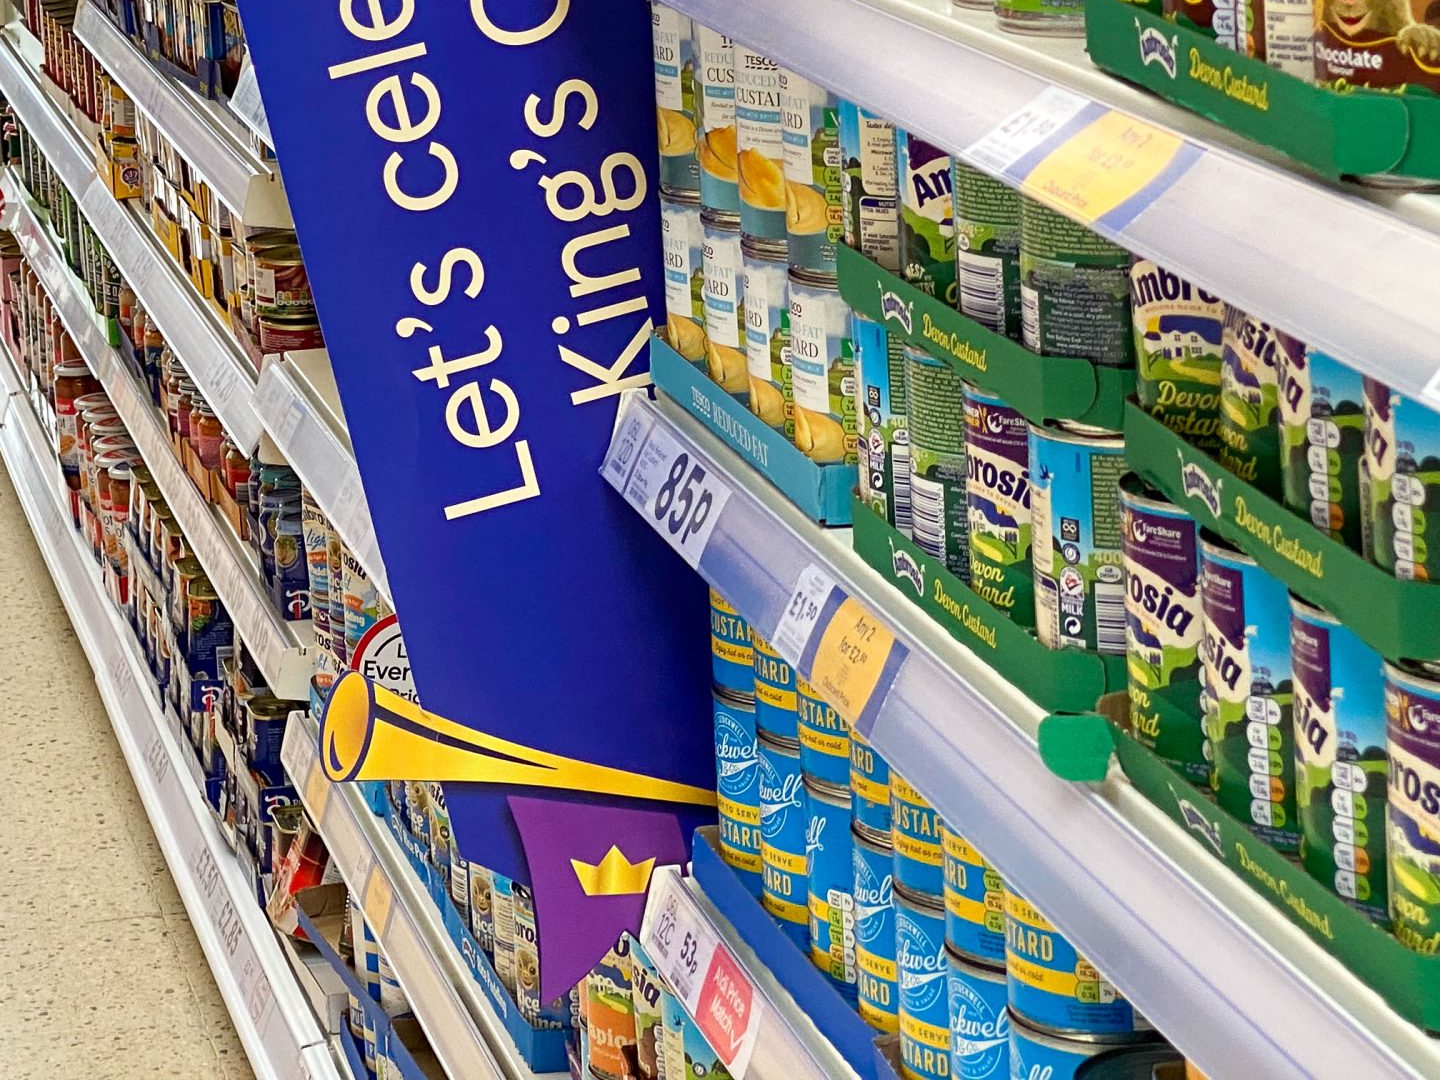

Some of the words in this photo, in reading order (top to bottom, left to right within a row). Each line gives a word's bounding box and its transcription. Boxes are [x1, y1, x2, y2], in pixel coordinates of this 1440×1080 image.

[744, 55, 778, 67] TESCO
[1314, 39, 1384, 72] Chocolate
[1189, 48, 1224, 95] Devon
[1223, 69, 1270, 113] Custard
[509, 78, 652, 406] King's
[922, 313, 951, 350] Devon
[949, 333, 987, 372] Custard
[396, 247, 541, 521] Let's
[691, 386, 711, 410] TESCO
[712, 401, 753, 452] REDUCED
[752, 434, 770, 467] FAT
[654, 452, 713, 545] 85p
[1144, 523, 1182, 541] FareShare
[1235, 497, 1271, 540] Devon
[1270, 526, 1324, 578] Custard
[789, 591, 818, 622] £1.50
[853, 616, 869, 639] Any
[867, 626, 877, 643] 2
[933, 578, 962, 621] Devon
[961, 600, 997, 650] Custard
[1061, 603, 1084, 616] MILK
[838, 635, 850, 656] for
[770, 851, 792, 867] SERVE
[1237, 842, 1274, 893] Devon
[1272, 878, 1336, 941] Custard
[681, 931, 698, 976] 53p
[710, 995, 735, 1037] Match
[713, 965, 729, 996] Aldi
[726, 982, 745, 1019] Price
